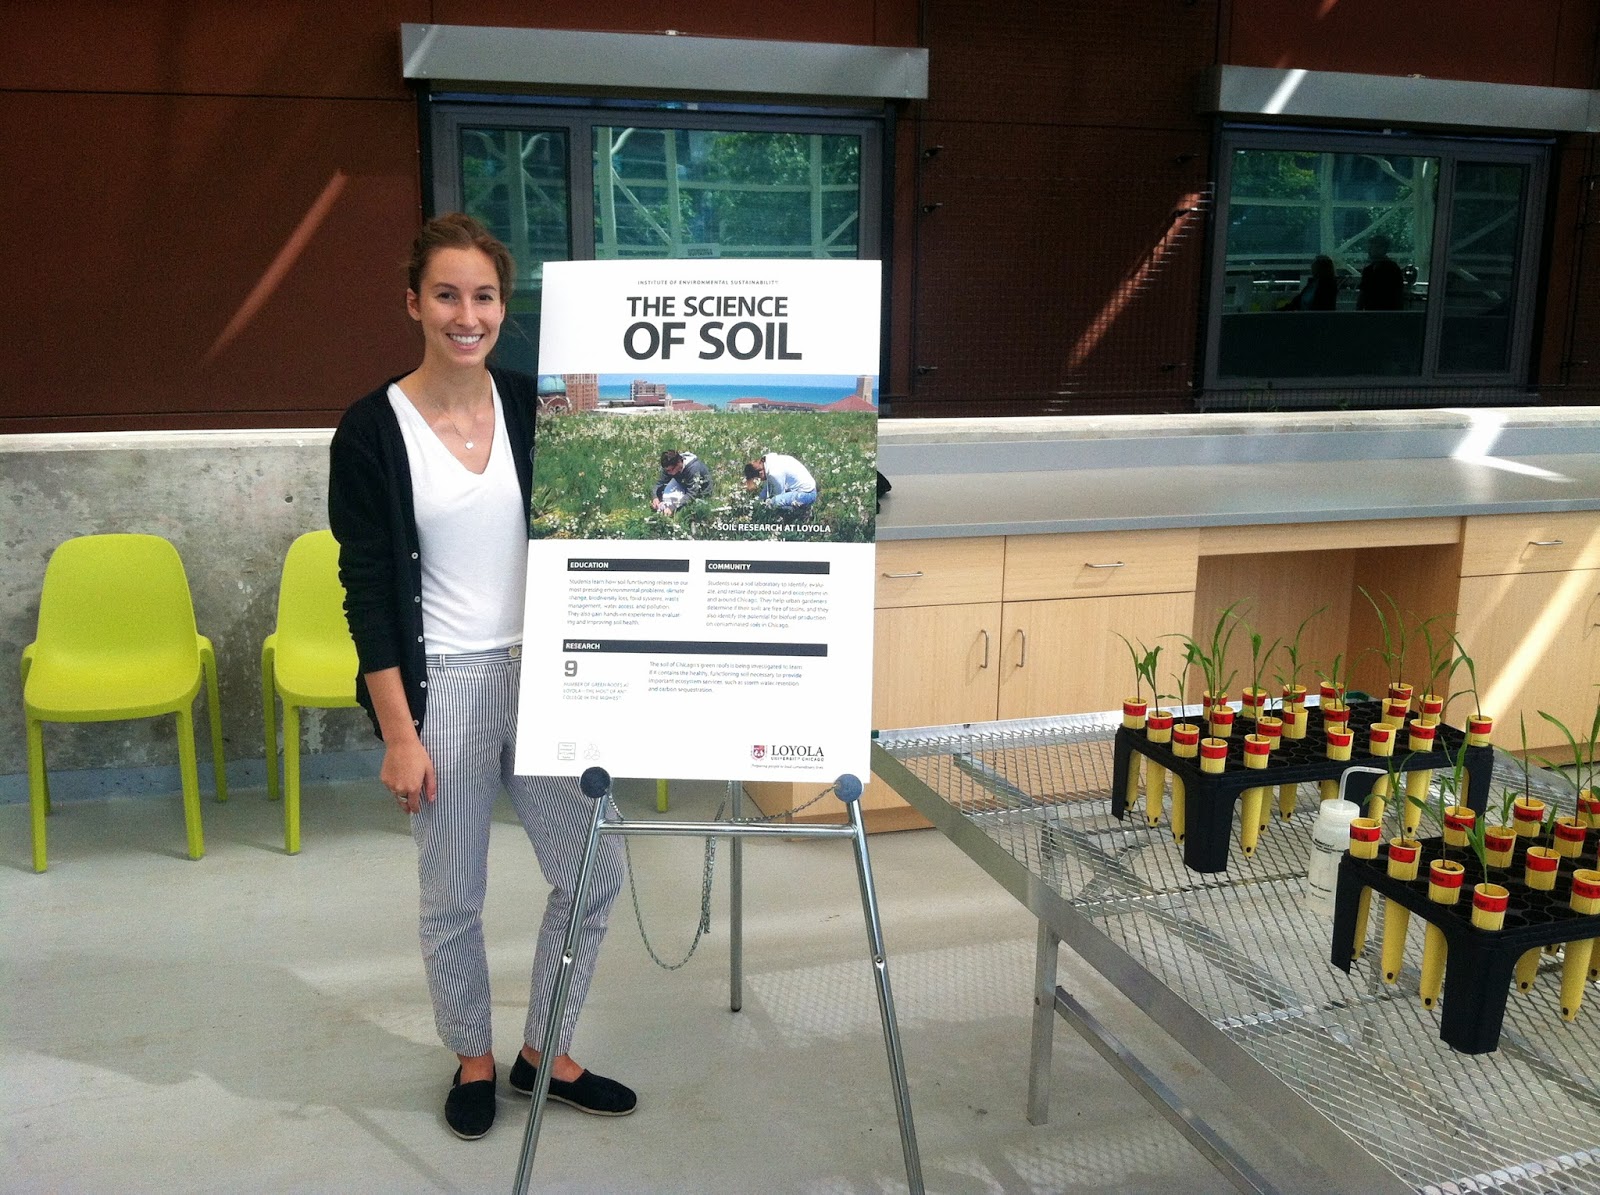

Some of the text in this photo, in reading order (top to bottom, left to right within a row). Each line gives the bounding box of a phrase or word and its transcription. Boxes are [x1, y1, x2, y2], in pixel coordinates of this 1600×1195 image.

[627, 296, 788, 317] THE SCIENCE
[624, 321, 802, 360] OF SOIL
[565, 660, 578, 677] 9
[771, 745, 824, 756] LOYOLA
